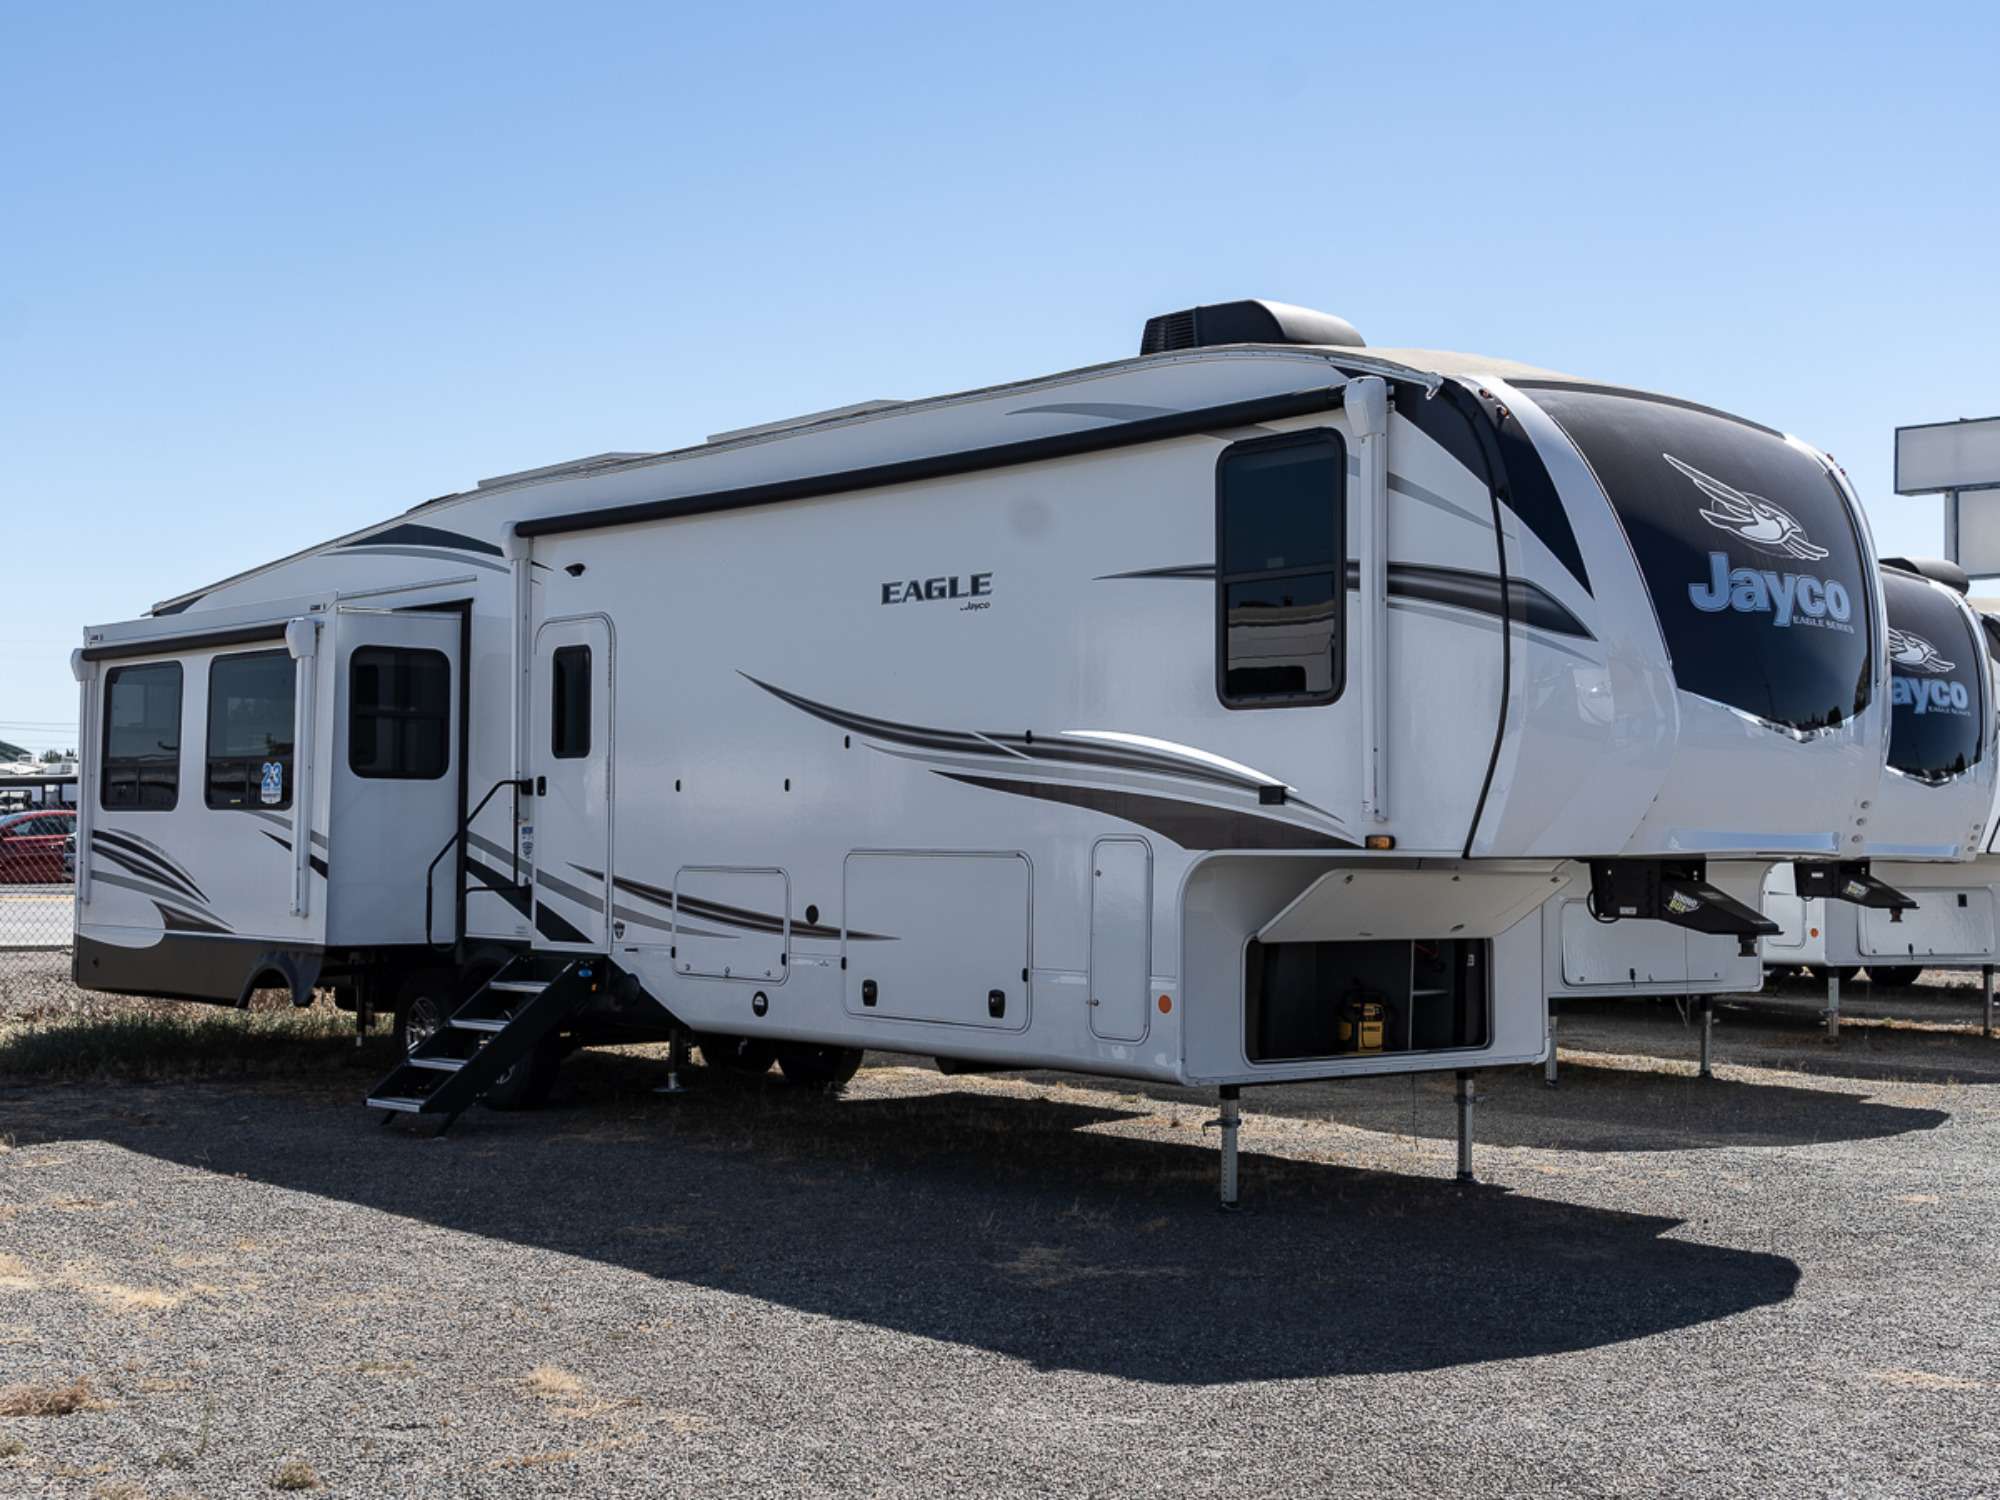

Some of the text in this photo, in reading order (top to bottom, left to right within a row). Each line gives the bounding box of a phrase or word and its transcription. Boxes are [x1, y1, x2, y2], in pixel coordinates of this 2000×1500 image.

[881, 572, 993, 605] EAGLE
[1688, 551, 1850, 627] Jayco
[1793, 616, 1825, 628] EAGLE
[1892, 676, 1968, 714] ayco
[262, 762, 282, 789] 23
